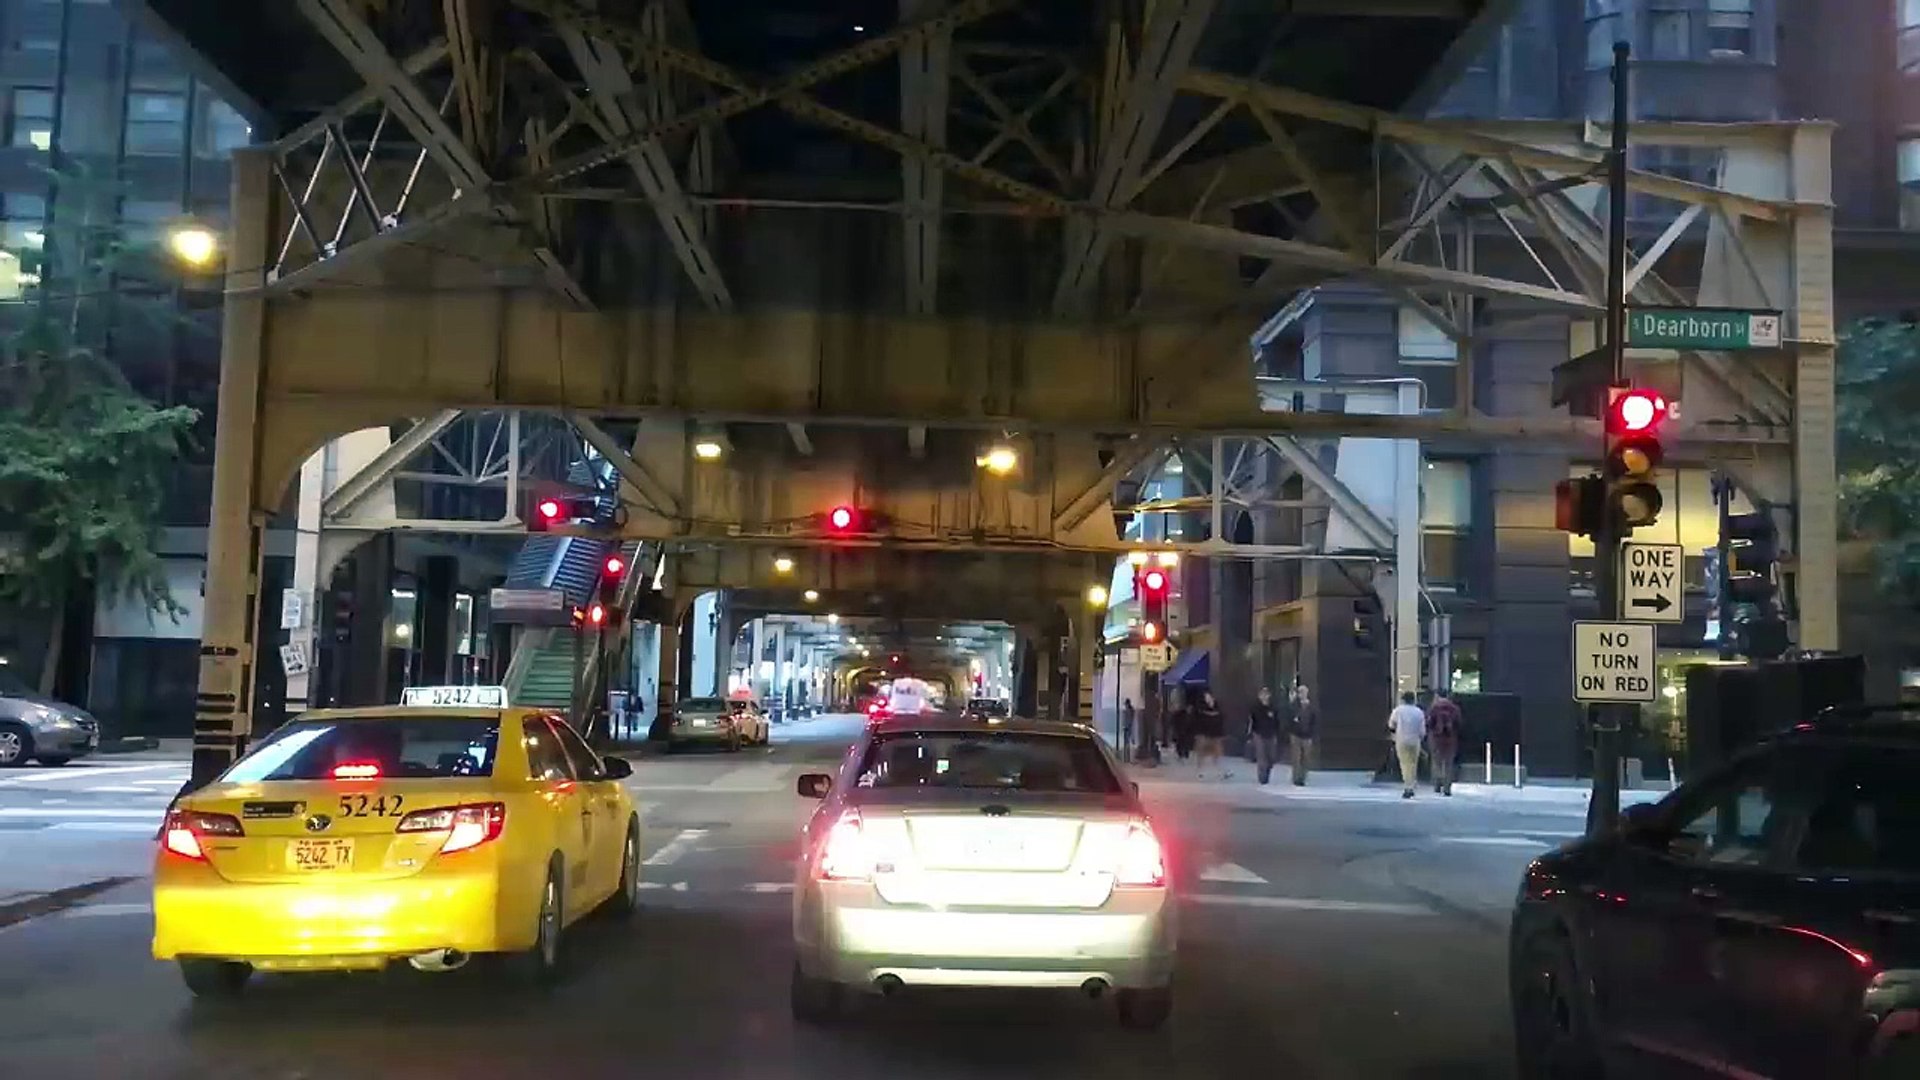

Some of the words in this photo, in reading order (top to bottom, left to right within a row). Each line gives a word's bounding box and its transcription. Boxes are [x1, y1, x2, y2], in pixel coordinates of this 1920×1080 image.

[1644, 314, 1730, 338] Dearborn
[1632, 549, 1674, 567] ONE
[1630, 570, 1674, 588] WAY
[1600, 632, 1629, 648] NO
[1591, 654, 1639, 670] TURN
[1581, 676, 1605, 691] ON
[1615, 676, 1649, 692] RED
[432, 689, 471, 705] 5242
[339, 794, 404, 818] 5242
[336, 846, 351, 864] TX
